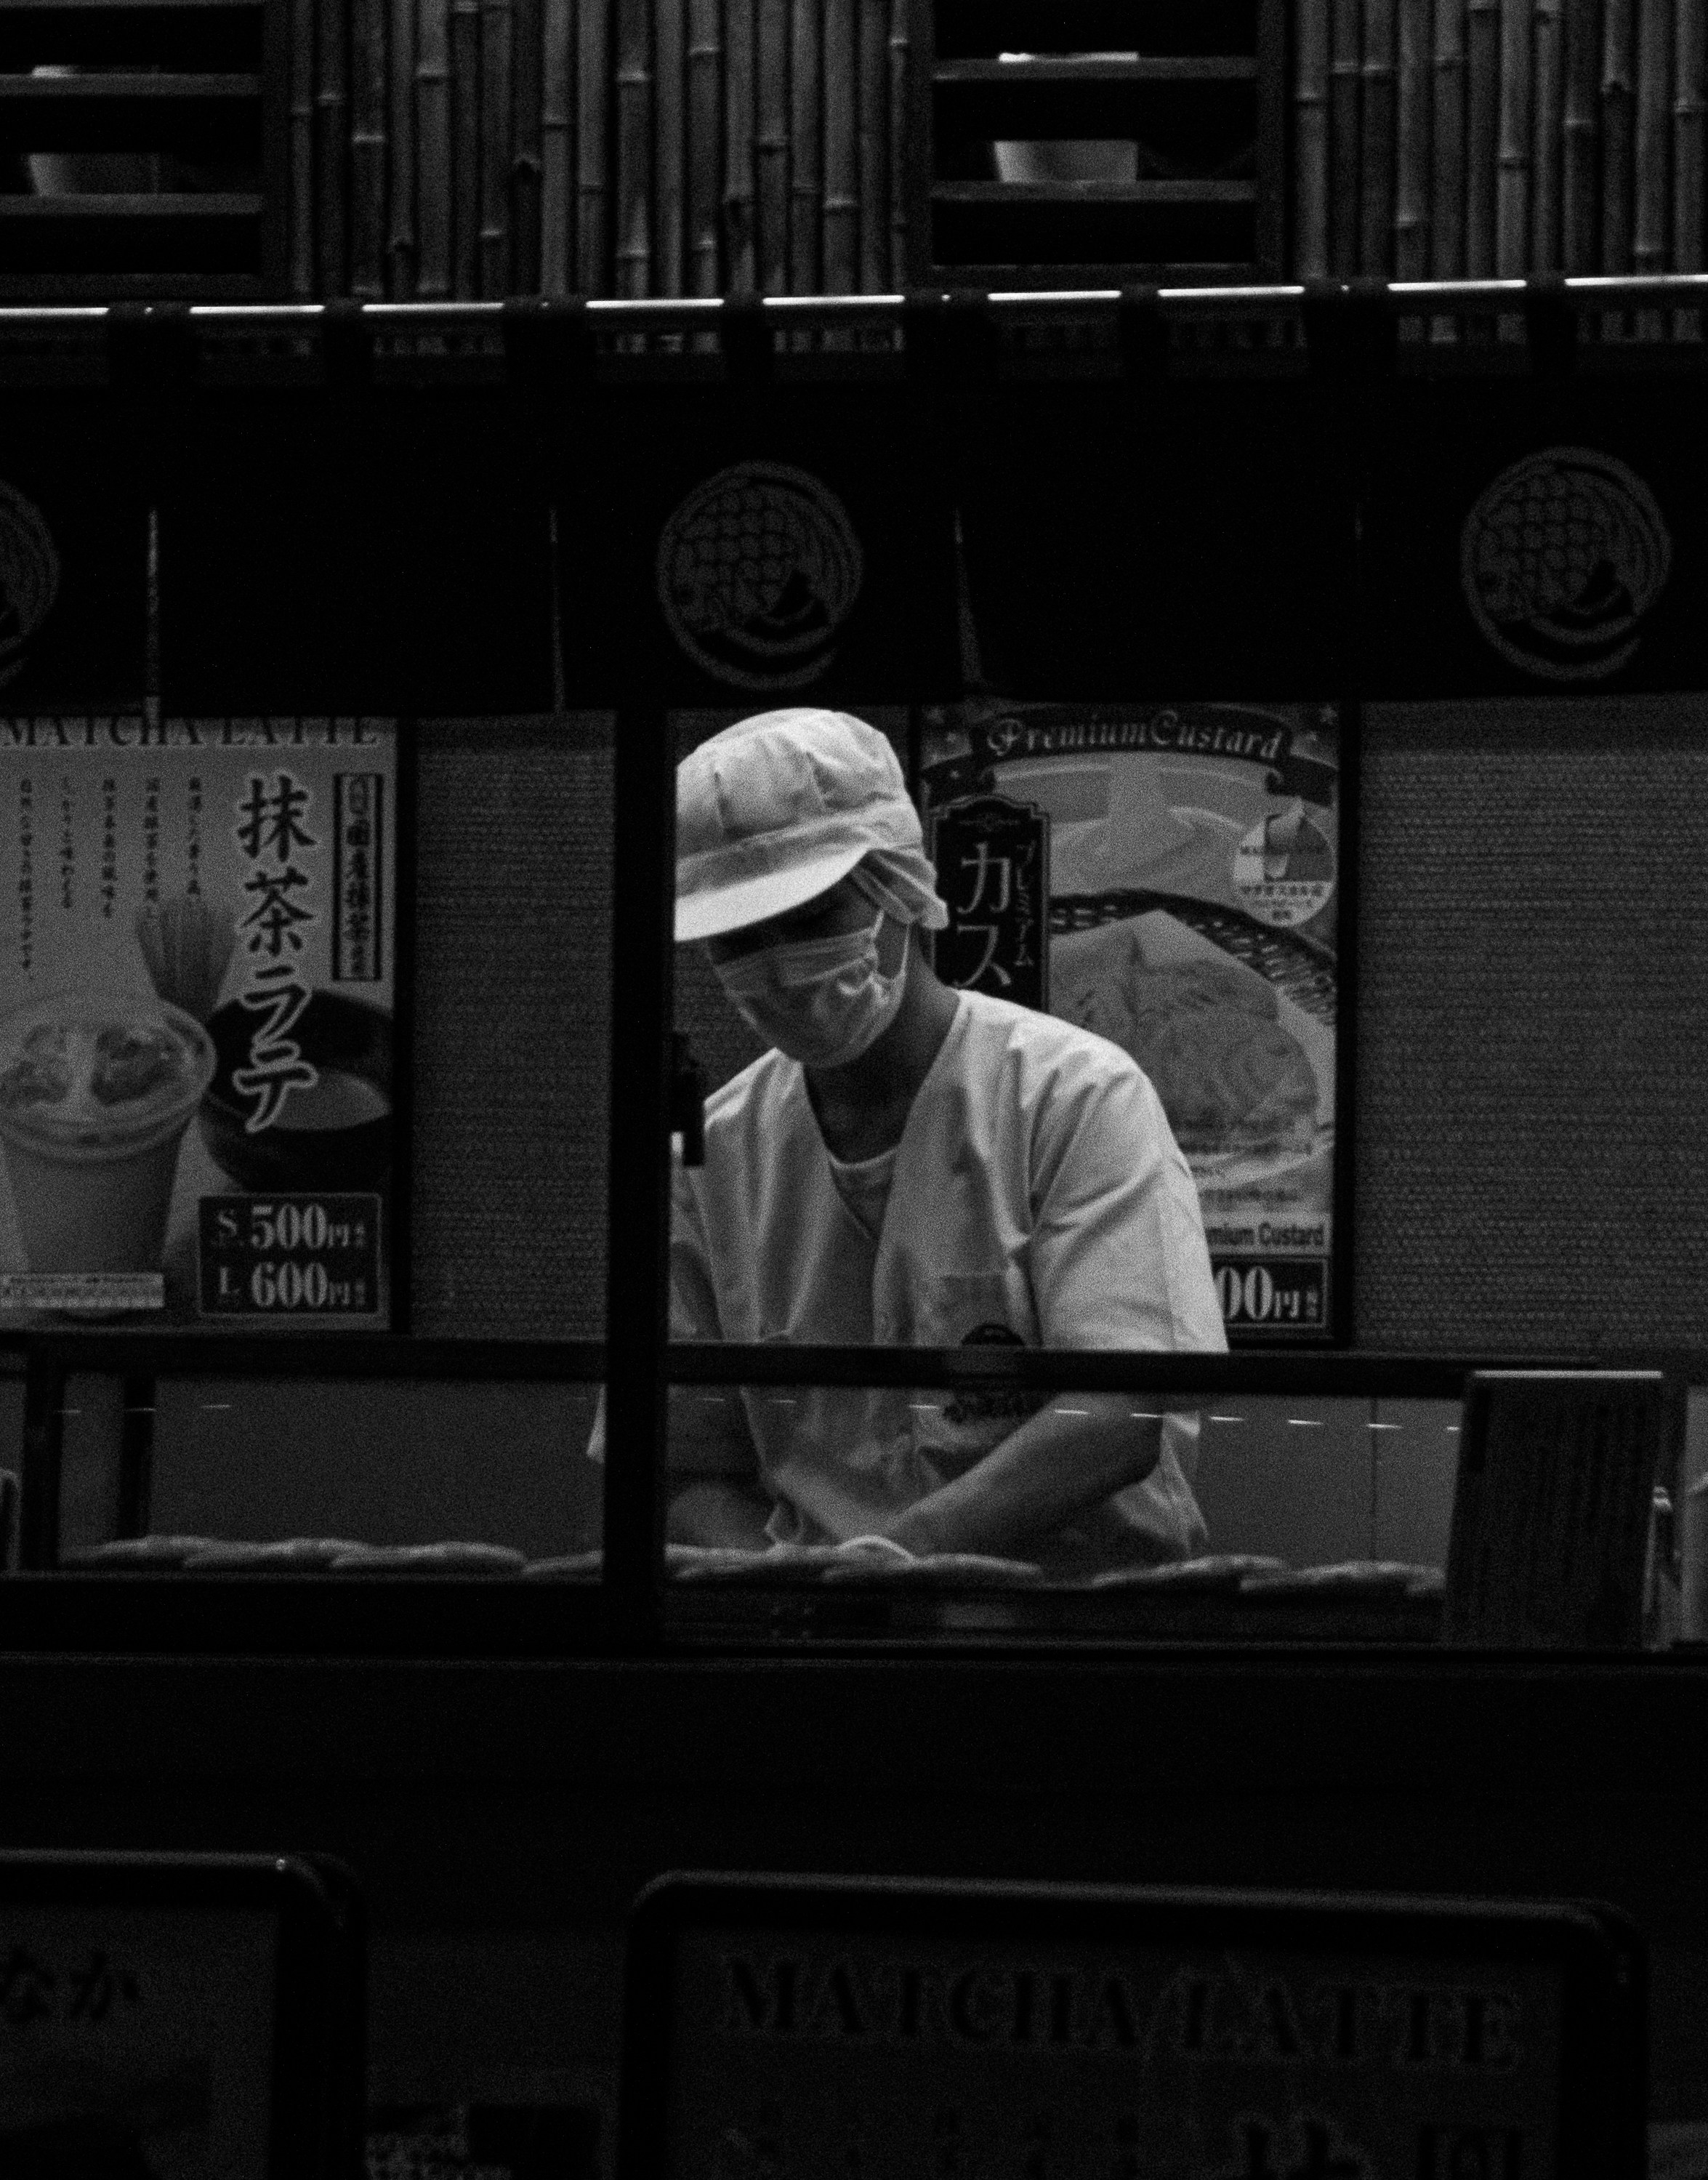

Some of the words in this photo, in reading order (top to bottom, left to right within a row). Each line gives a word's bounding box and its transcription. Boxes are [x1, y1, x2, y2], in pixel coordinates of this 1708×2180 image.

[2, 716, 204, 747] MATCHA
[219, 716, 378, 747] LATTE
[986, 714, 1148, 757] Premium
[1150, 709, 1283, 759] Custard
[955, 840, 1012, 986] カス
[237, 774, 318, 1132] 抹茶ラテ
[217, 1209, 238, 1238] S
[250, 1202, 350, 1250] 500円
[1258, 1221, 1325, 1247] Custard
[219, 1266, 241, 1295] L
[250, 1260, 350, 1308] 600円
[727, 1955, 1140, 2050] MATCHA
[1176, 1979, 1519, 2066] LATTE
